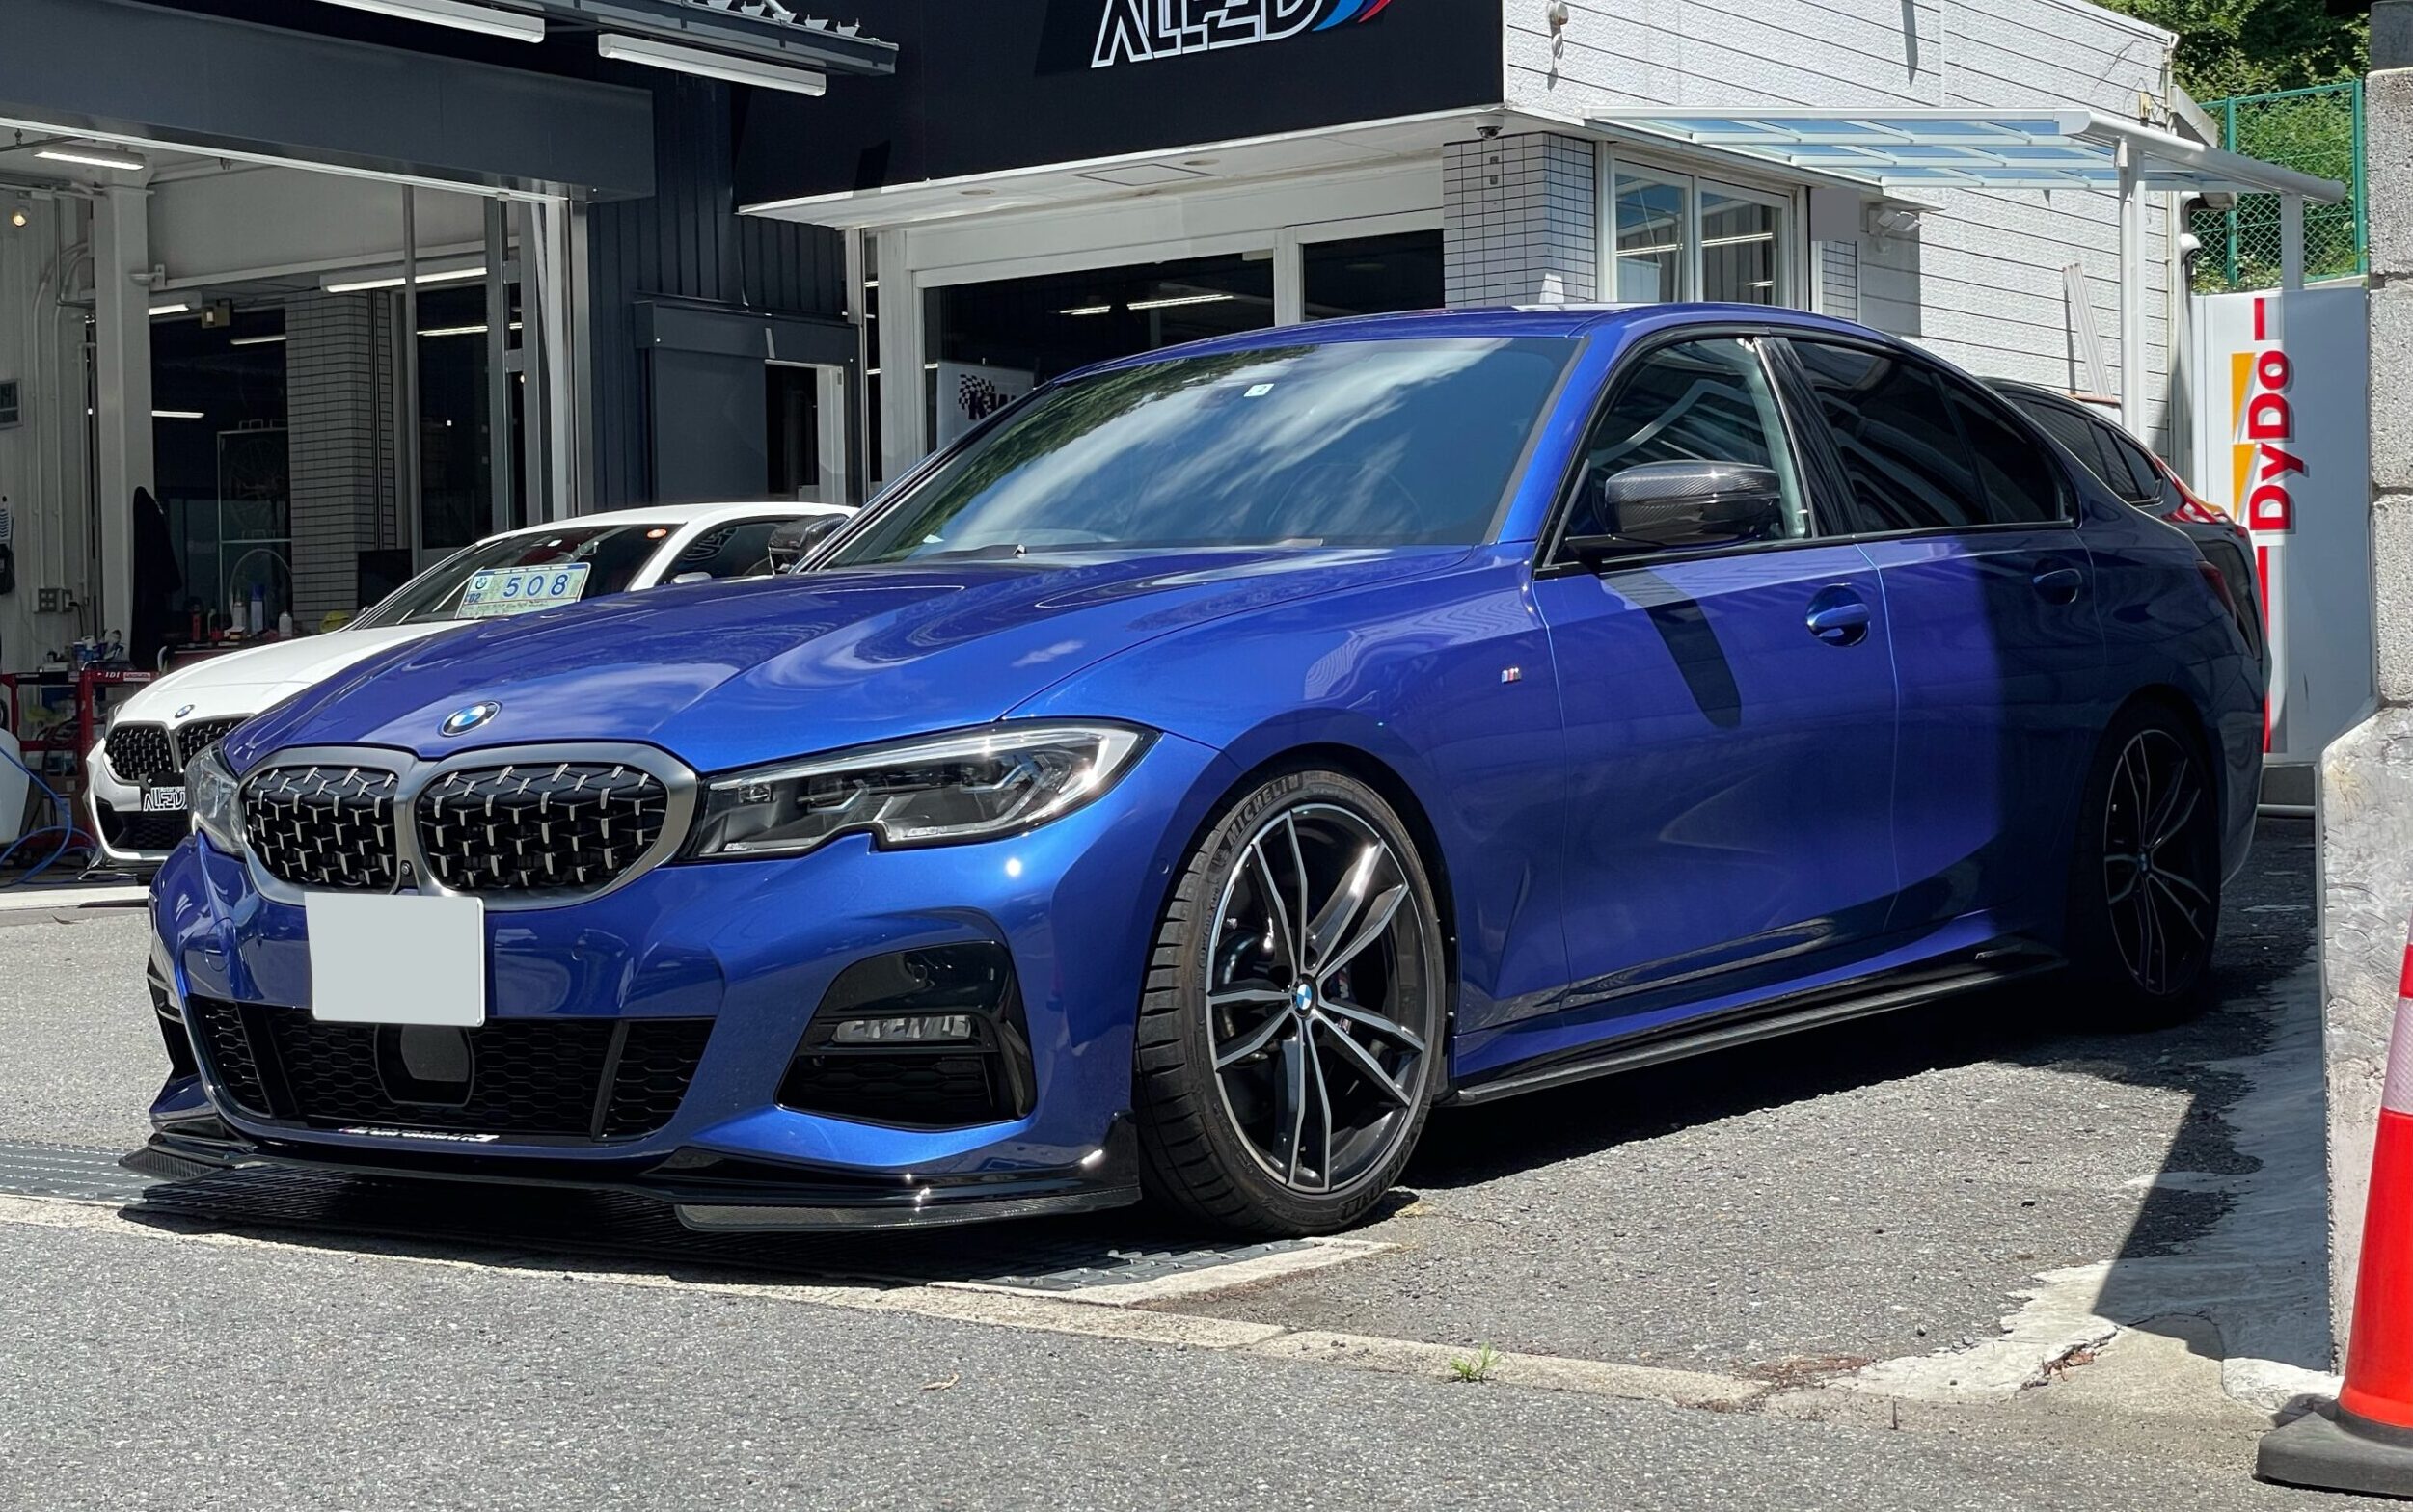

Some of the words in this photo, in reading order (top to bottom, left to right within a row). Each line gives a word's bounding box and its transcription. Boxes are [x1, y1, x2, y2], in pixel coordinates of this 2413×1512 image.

[2248, 349, 2305, 531] DyDo
[503, 574, 568, 597] 508
[1226, 774, 1300, 847] MICHELIN
